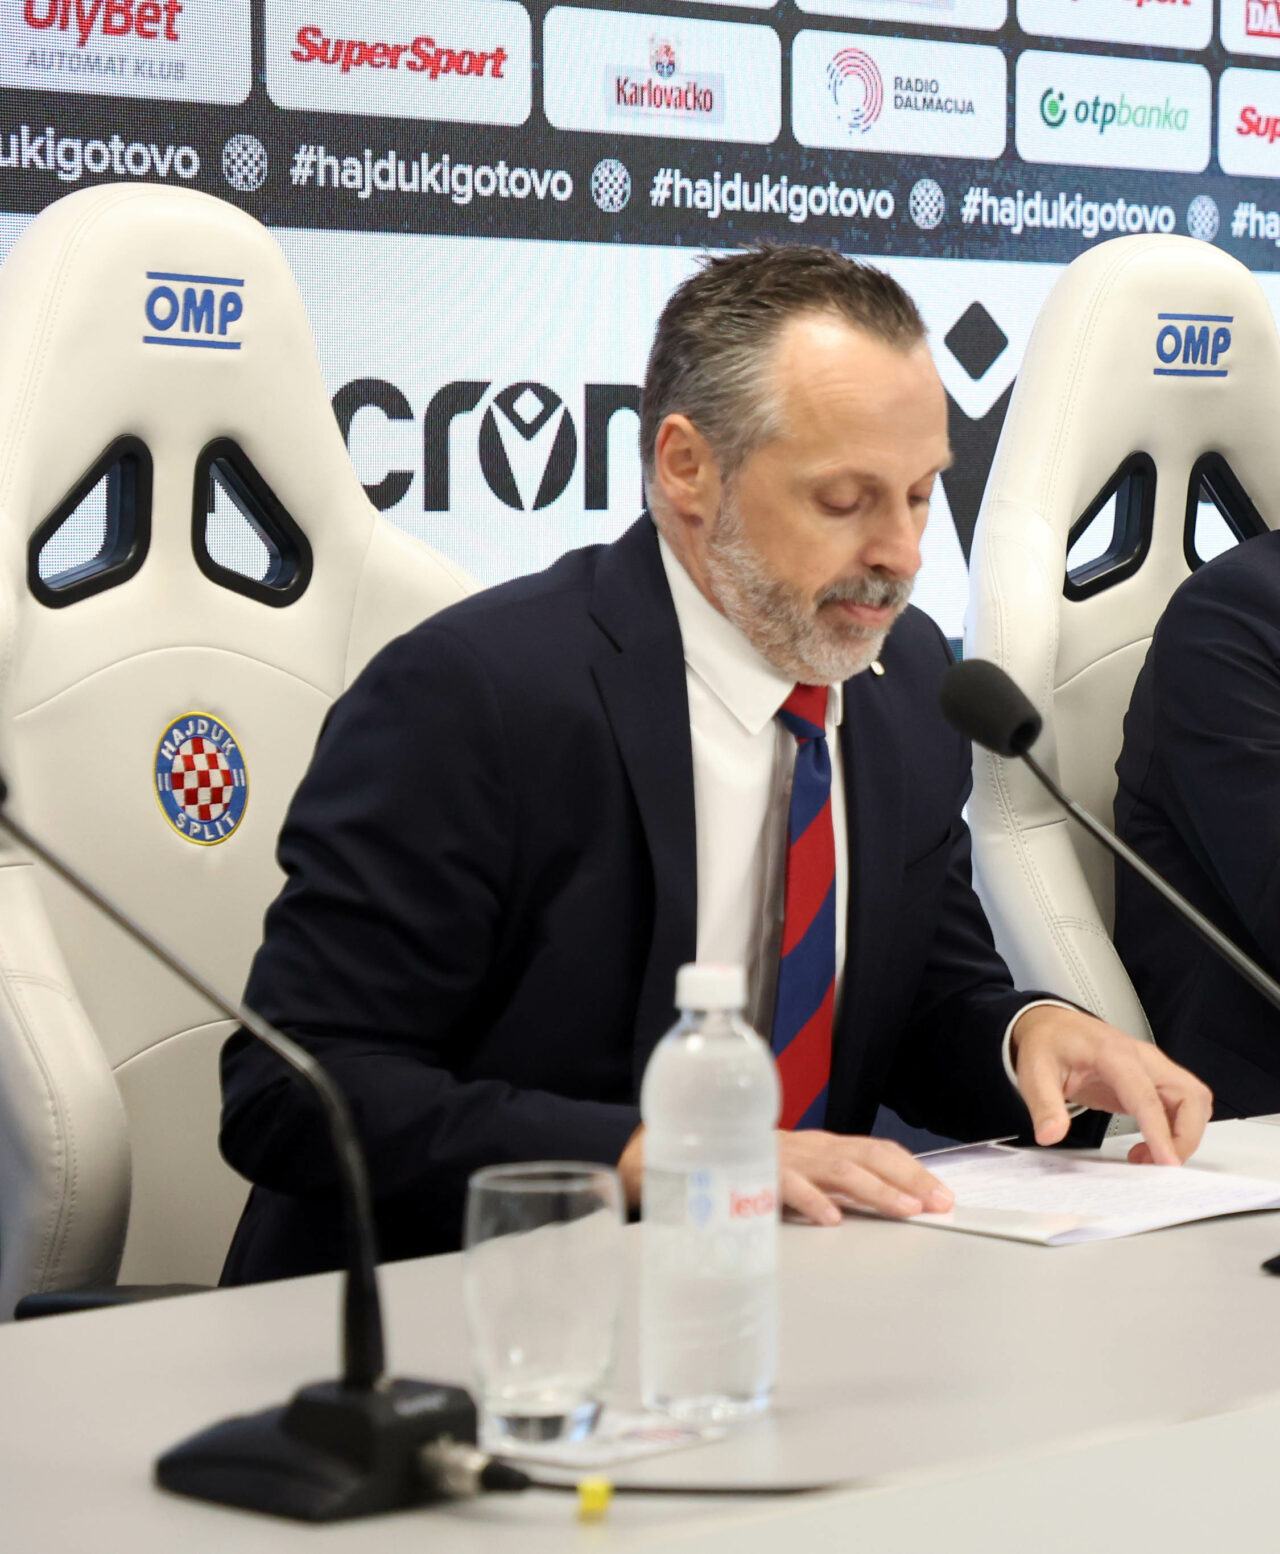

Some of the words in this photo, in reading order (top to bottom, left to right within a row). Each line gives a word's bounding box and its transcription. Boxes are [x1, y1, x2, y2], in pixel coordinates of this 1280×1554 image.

[26, 49, 128, 76] AUTOMAT
[133, 57, 187, 81] KLUB
[291, 26, 507, 80] SuperSport
[893, 94, 975, 115] DALMACIJA
[894, 76, 939, 94] RADIO
[1074, 97, 1190, 134] otpbanka
[289, 144, 574, 205] #hajdukigotovo
[649, 167, 895, 221] #hajdukigotovo
[961, 186, 1176, 234] #hajdukigotovo
[145, 285, 243, 336] OMP
[1156, 323, 1232, 366] OMP
[161, 719, 236, 761] HAJDUK
[175, 811, 235, 840] SPLIT
